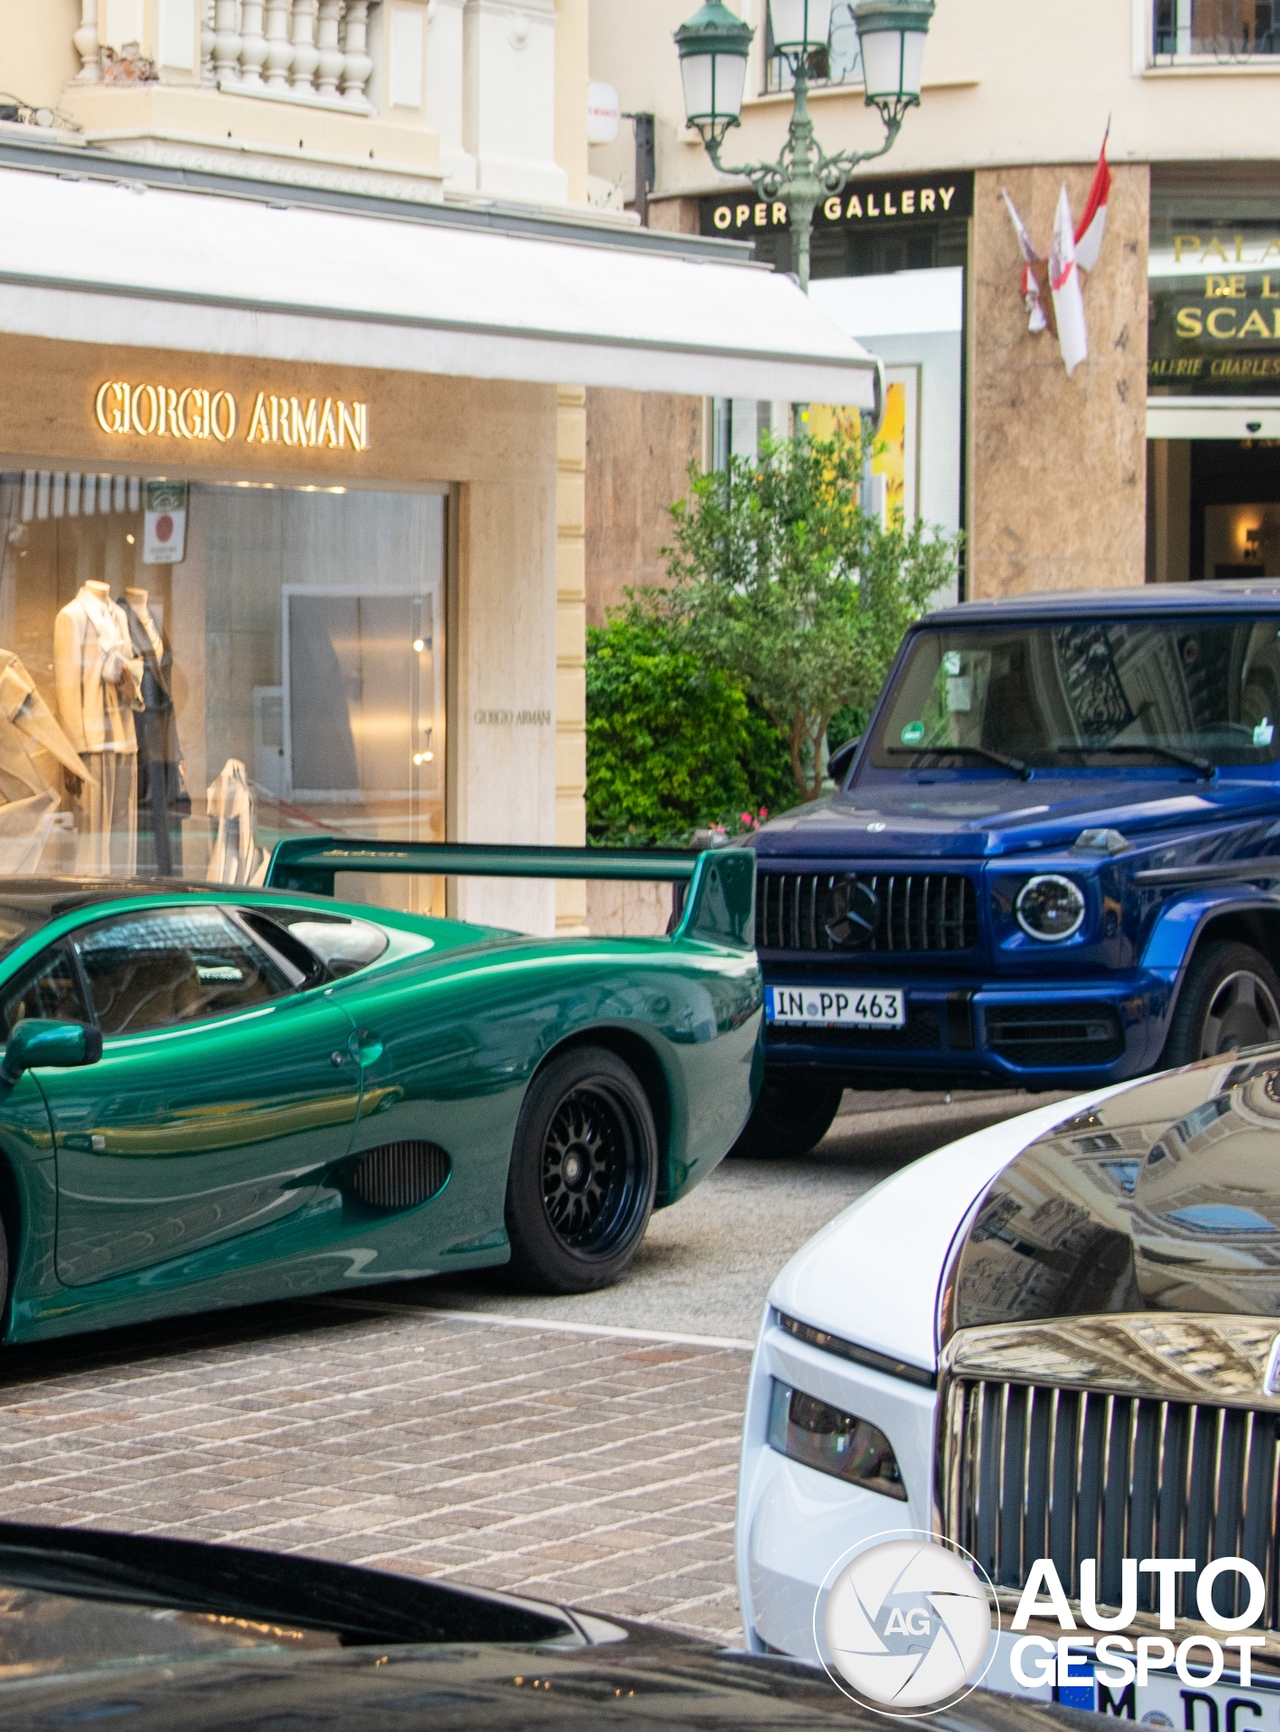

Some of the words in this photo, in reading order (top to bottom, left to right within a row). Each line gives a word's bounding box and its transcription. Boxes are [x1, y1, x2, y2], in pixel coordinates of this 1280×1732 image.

[713, 201, 788, 230] OPER
[823, 186, 956, 221] GALLERY
[1204, 274, 1247, 299] DE
[1149, 357, 1203, 377] ALERIE
[95, 381, 239, 442] GIORGIO
[247, 391, 370, 452] ARMANI
[778, 991, 804, 1016] IN
[819, 993, 849, 1017] PP
[855, 994, 898, 1019] 463
